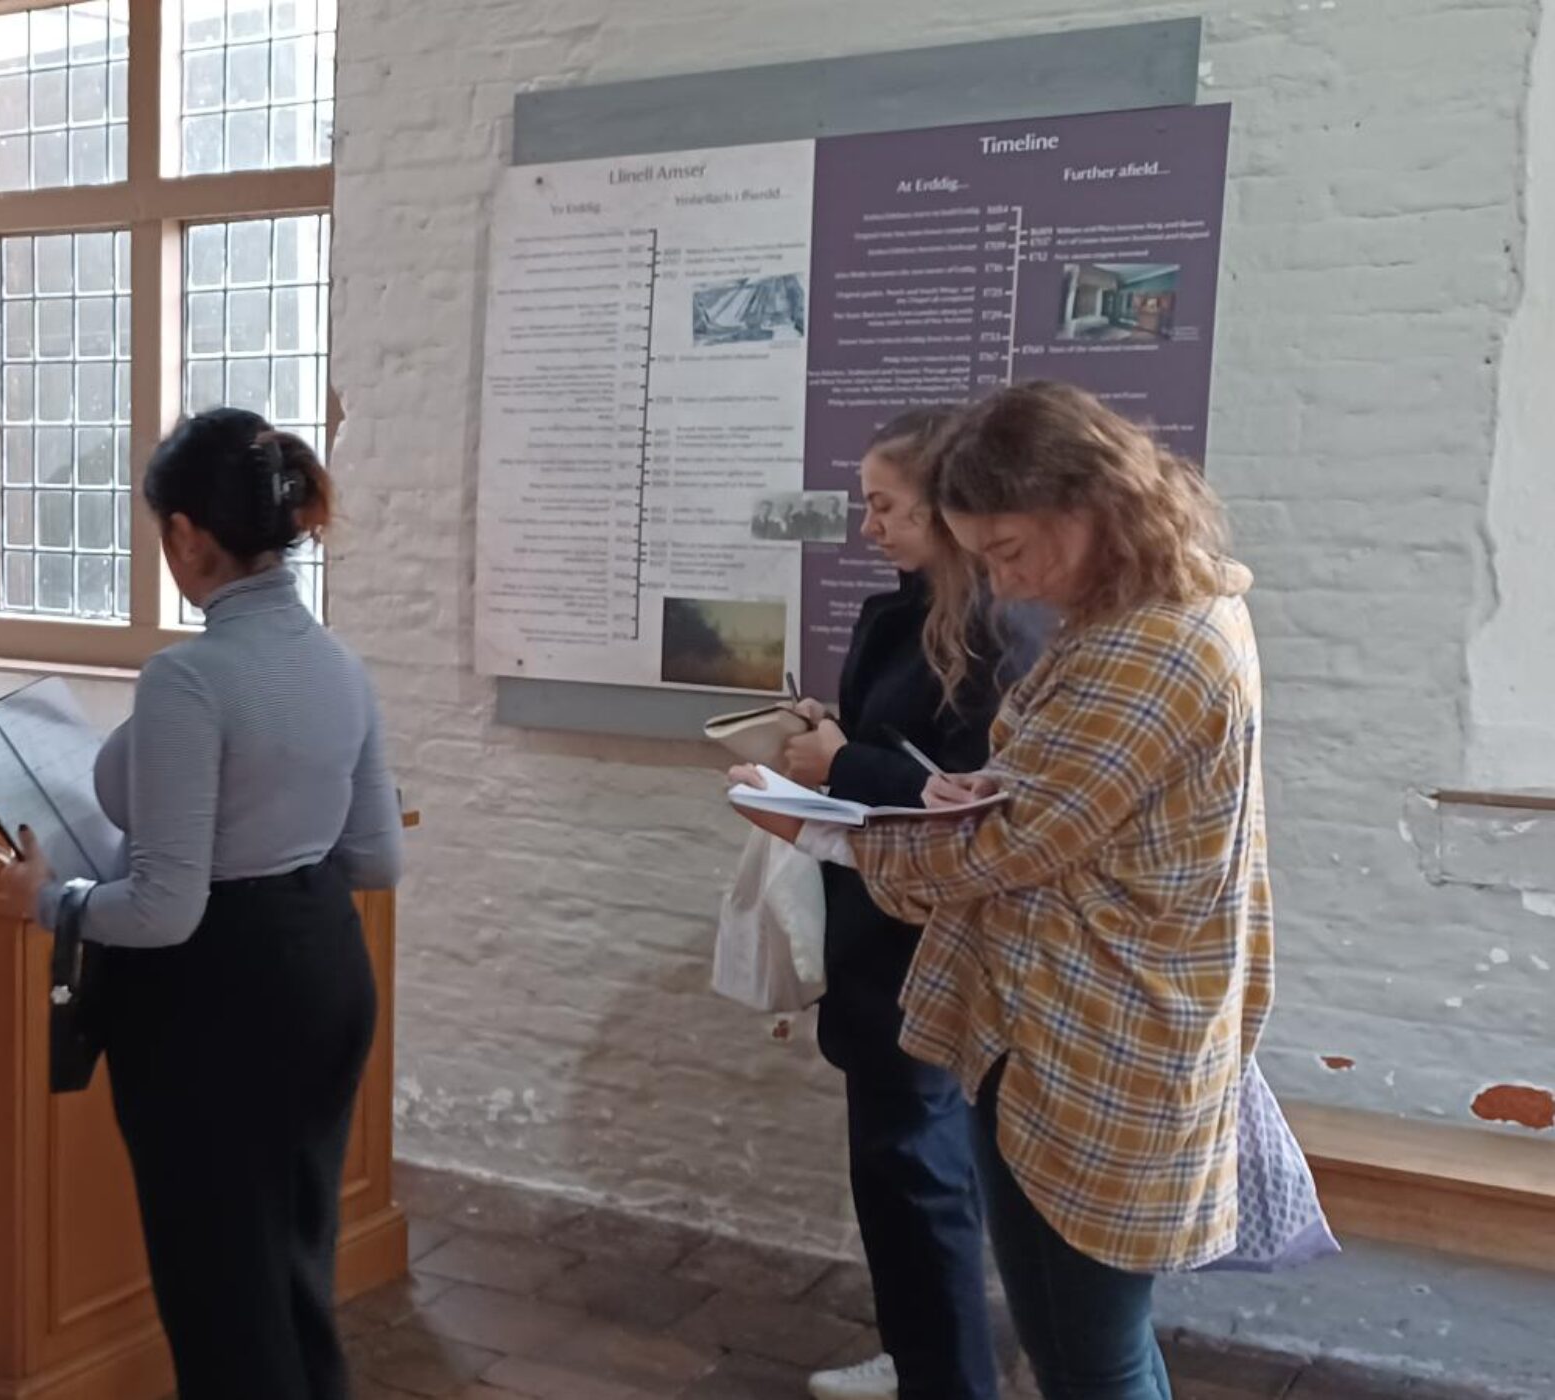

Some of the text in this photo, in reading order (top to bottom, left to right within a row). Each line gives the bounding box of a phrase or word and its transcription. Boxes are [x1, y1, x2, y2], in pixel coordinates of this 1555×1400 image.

[978, 131, 1060, 155] Timeline
[608, 162, 708, 186] Llinell Amser
[1063, 165, 1116, 182] Further
[896, 180, 912, 193] At
